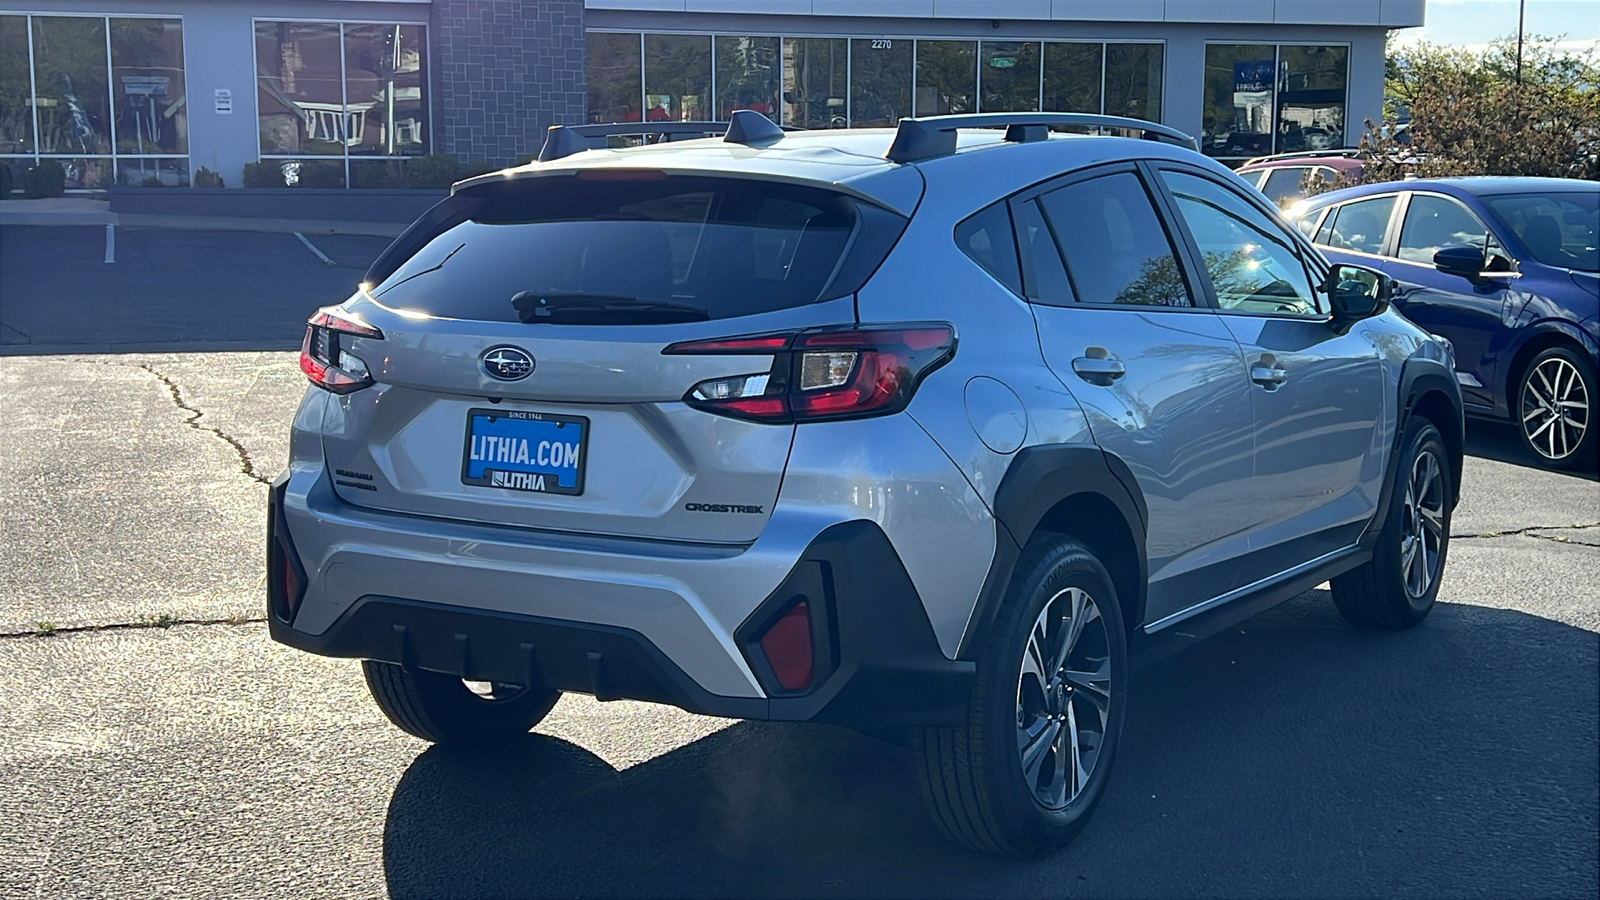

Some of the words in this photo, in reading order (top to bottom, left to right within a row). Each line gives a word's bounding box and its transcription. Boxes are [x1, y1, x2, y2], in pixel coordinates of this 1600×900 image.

[872, 39, 891, 49] 2270
[508, 411, 528, 419] SINCE
[470, 435, 580, 469] LITHIA.COM
[336, 469, 373, 480] SUBARU
[503, 471, 545, 491] LITHIA
[685, 503, 763, 514] CROSSTREK
